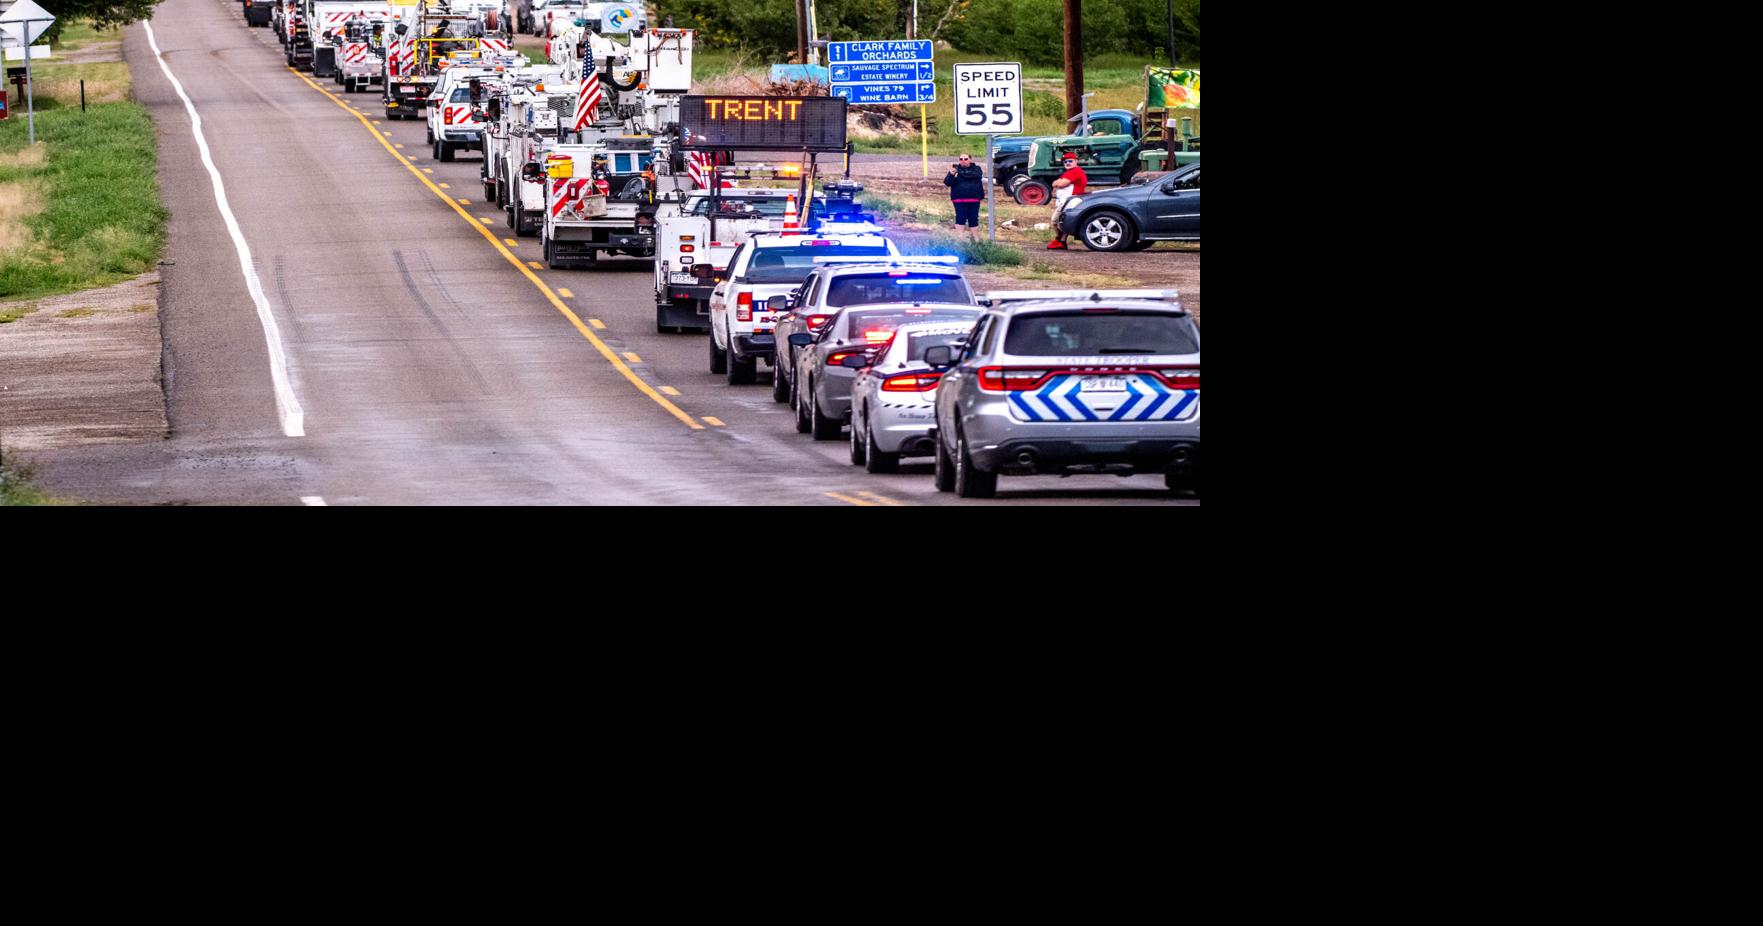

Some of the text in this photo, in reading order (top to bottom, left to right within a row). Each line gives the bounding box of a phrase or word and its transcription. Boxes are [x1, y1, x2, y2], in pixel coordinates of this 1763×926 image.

[852, 42, 925, 52] CLARK FAMILY
[862, 51, 917, 60] ORCHARDS
[882, 63, 915, 71] SPECTRUM
[961, 71, 1015, 82] SPEED
[967, 87, 1009, 98] LIMIT
[885, 94, 909, 102] BARN
[705, 99, 803, 121] TRENT
[965, 103, 1013, 126] 55
